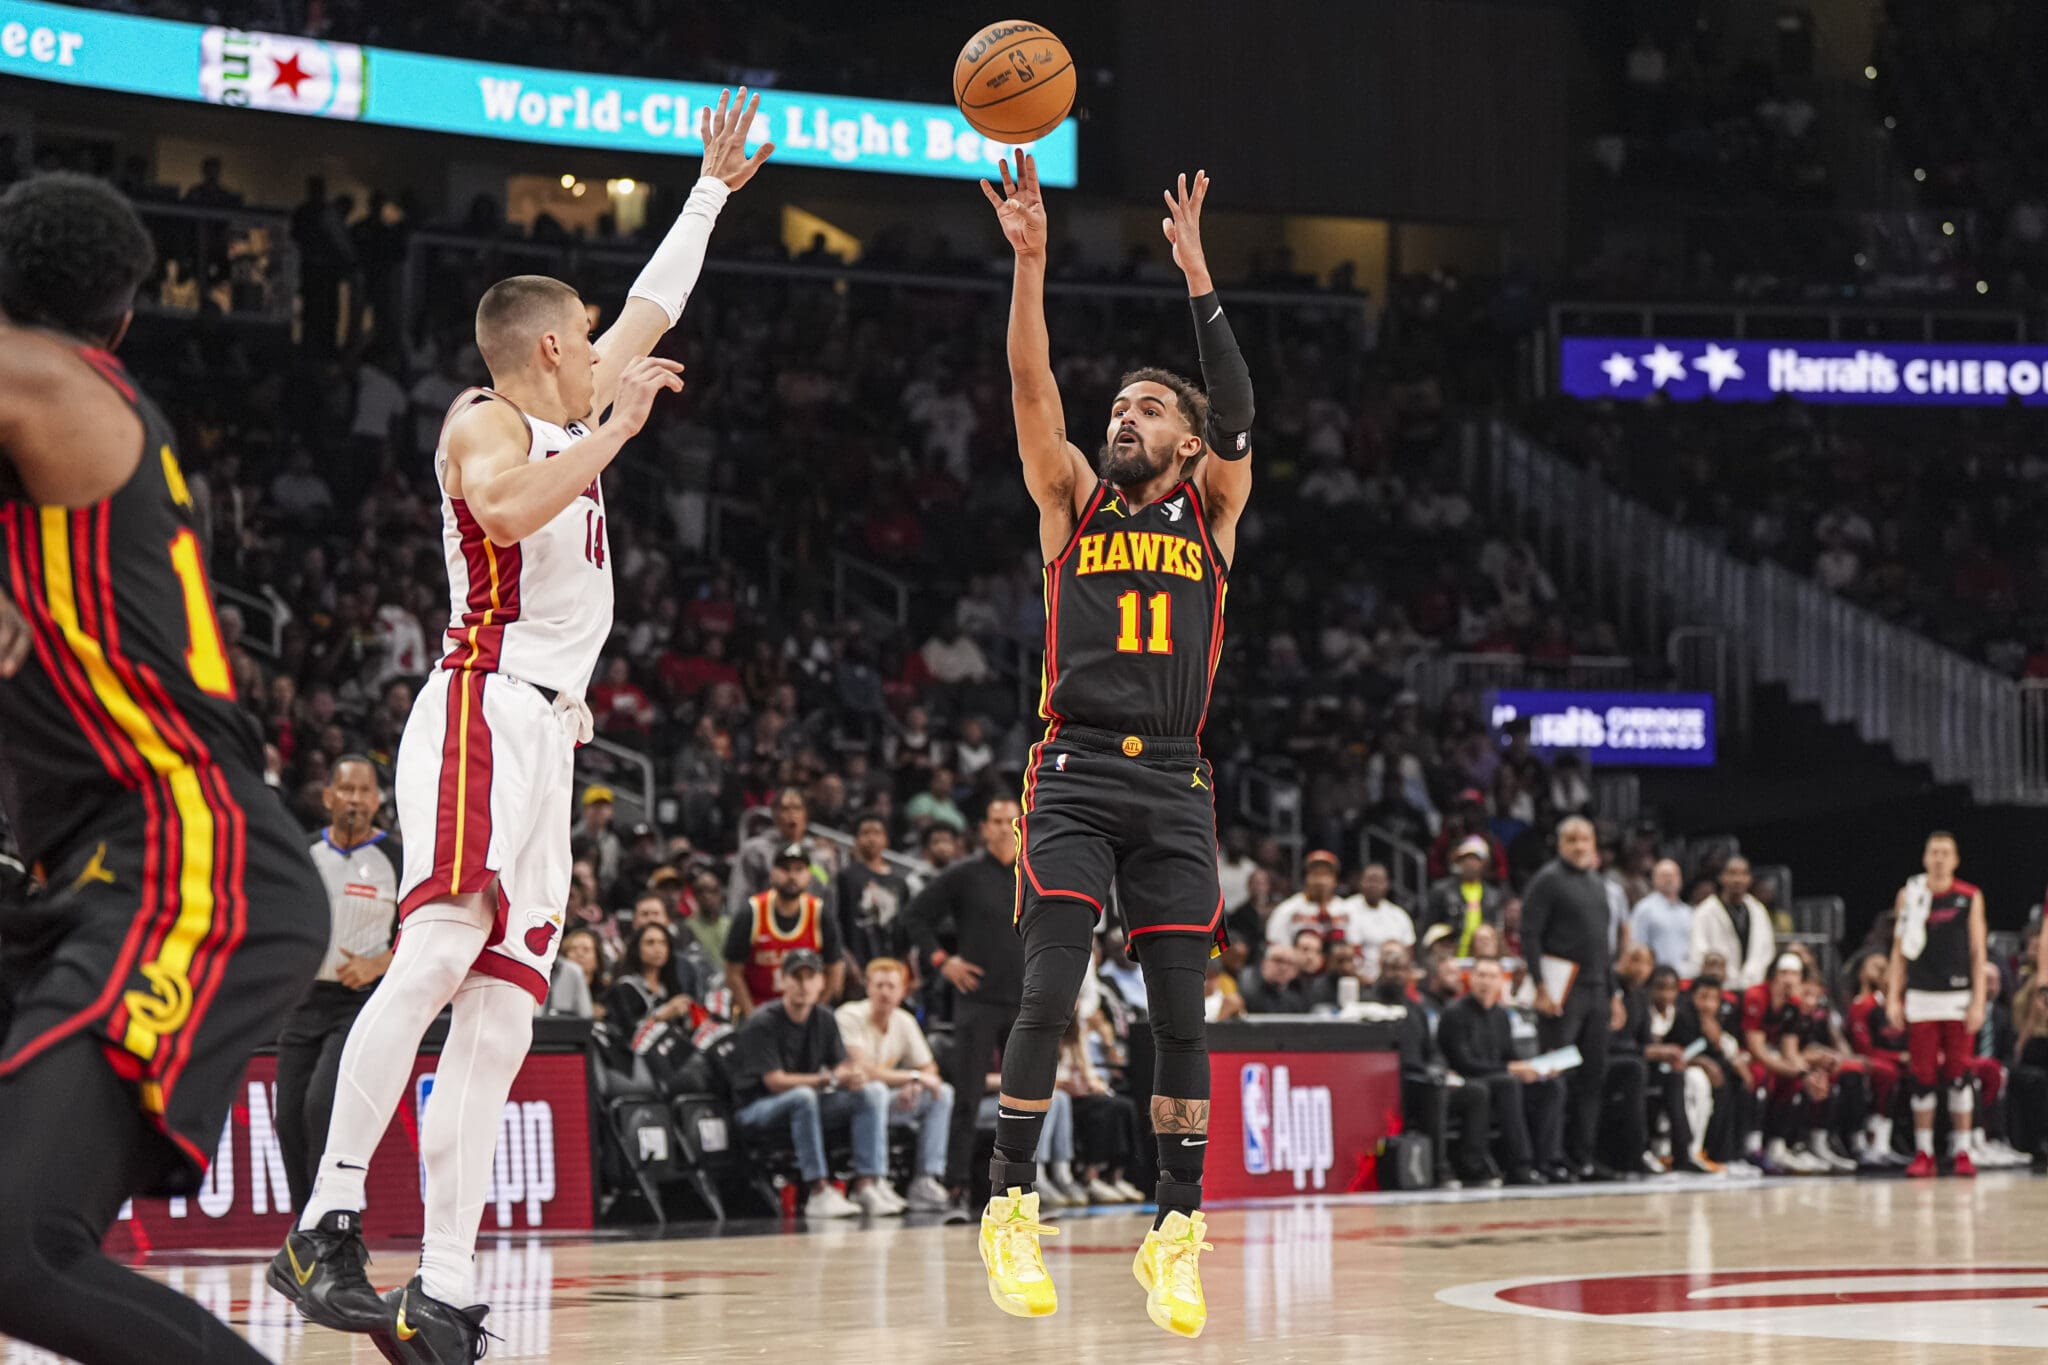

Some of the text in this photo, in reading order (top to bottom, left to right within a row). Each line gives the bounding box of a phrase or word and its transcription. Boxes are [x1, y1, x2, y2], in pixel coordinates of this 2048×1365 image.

[480, 77, 770, 144] World-Cls
[785, 105, 910, 162] Light
[1903, 359, 2048, 395] CHERO
[585, 509, 605, 570] 14
[1076, 531, 1203, 582] HAWKS
[1116, 590, 1173, 655] 11
[1125, 741, 1140, 752] ATL
[486, 1100, 556, 1227] pp
